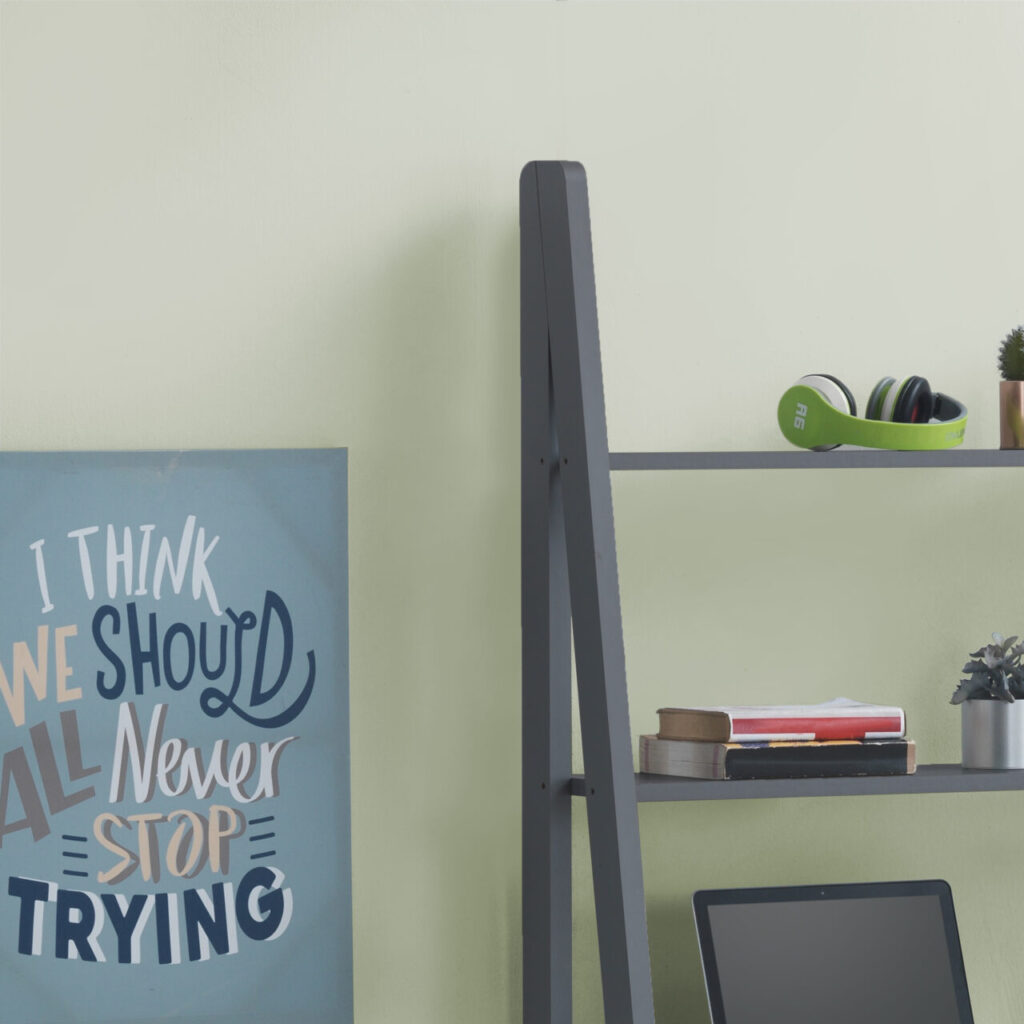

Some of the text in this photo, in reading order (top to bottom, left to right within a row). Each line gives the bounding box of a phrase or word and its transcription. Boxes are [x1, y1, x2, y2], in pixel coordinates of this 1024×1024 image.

[29, 514, 223, 616] I THINK
[0, 590, 316, 729] WE SHOULD
[0, 702, 300, 848] ALL Never
[93, 804, 247, 886] STOP
[8, 866, 293, 966] TRYING
